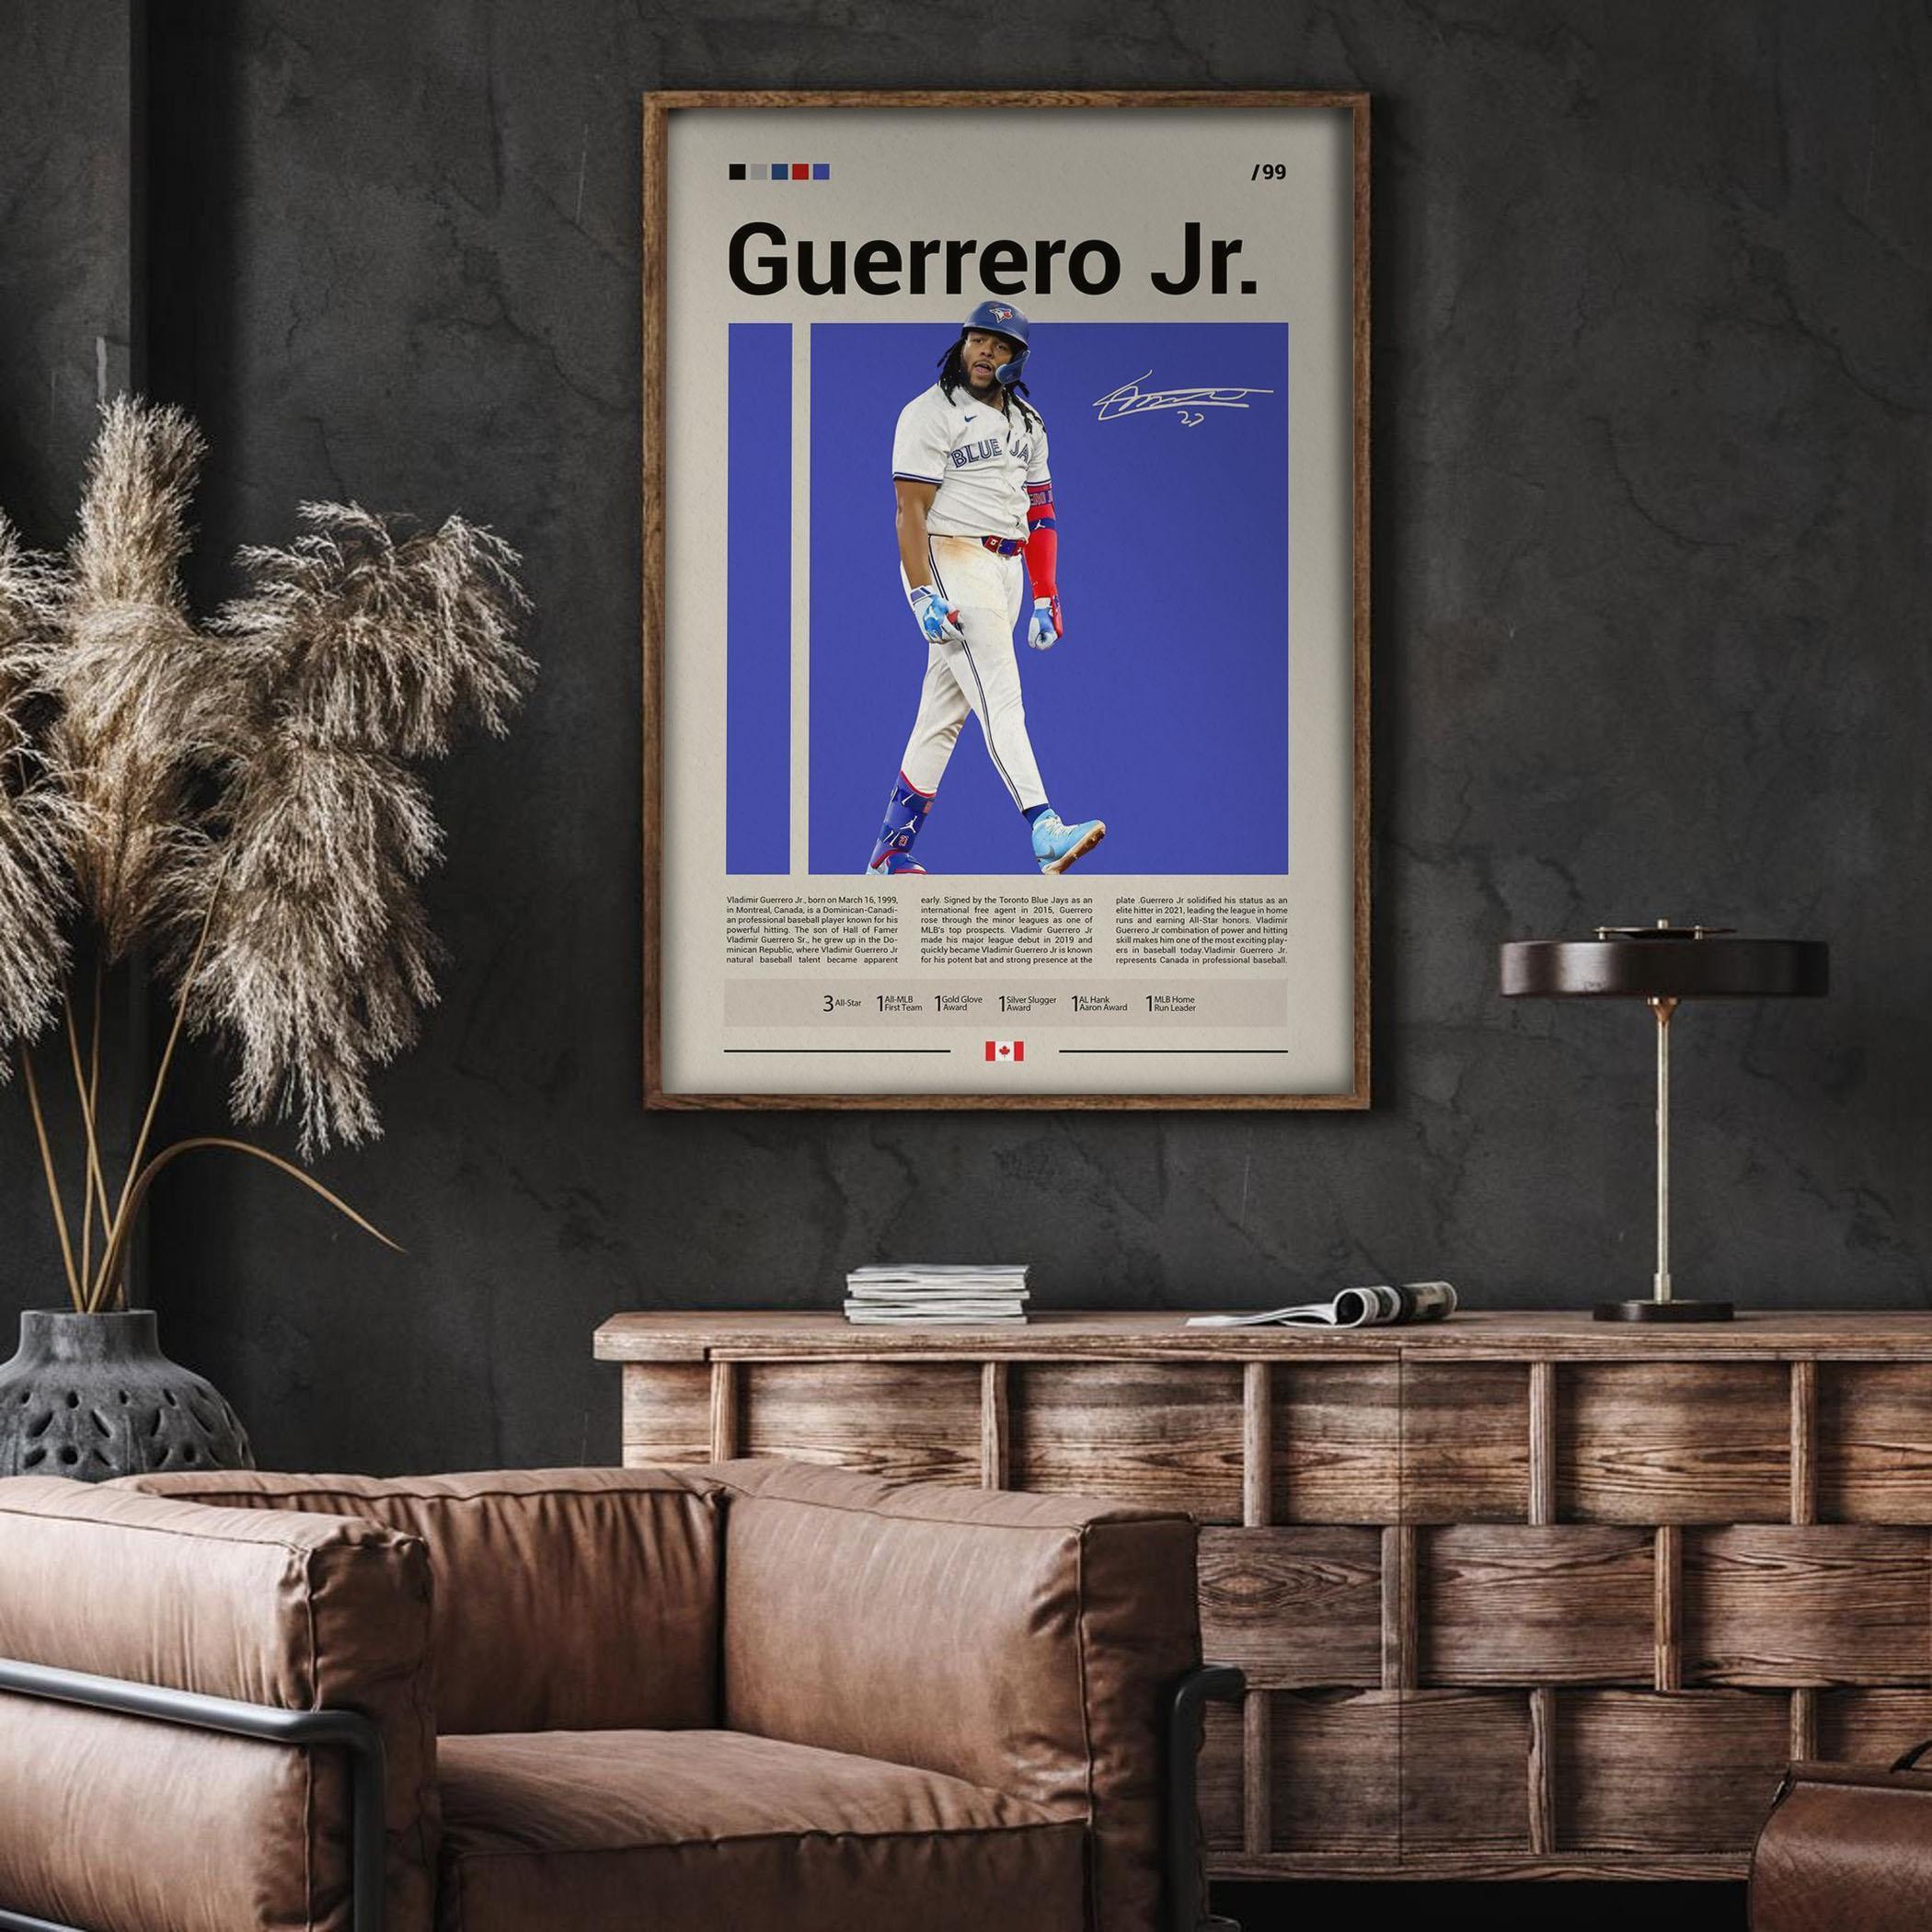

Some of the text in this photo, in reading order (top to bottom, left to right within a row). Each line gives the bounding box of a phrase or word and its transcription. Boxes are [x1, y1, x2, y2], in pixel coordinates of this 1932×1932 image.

[1251, 163, 1286, 180] /99
[729, 221, 1257, 295] Guerrero Jr.
[950, 438, 1003, 468] BLUE
[726, 896, 759, 904] Vladimir
[759, 896, 794, 904] Guerrero
[794, 896, 807, 905] Jr.,
[807, 896, 826, 904] born
[837, 896, 864, 904] March
[864, 896, 877, 905] 16,
[877, 896, 899, 905] 1999,
[920, 896, 942, 906] early.
[943, 896, 972, 906] Signed
[972, 896, 983, 906] by
[983, 896, 997, 904] the
[998, 896, 1029, 904] Toronto
[1030, 896, 1050, 904] Blue
[1050, 896, 1069, 906] Jays
[1115, 896, 1136, 906] plate
[1176, 896, 1184, 904] Jr
[1187, 896, 1223, 904] solidified
[1224, 896, 1236, 904] his
[1238, 896, 1264, 904] status
[726, 905, 734, 914] in
[735, 905, 773, 915] Montreal,
[773, 905, 805, 915] Canada,
[806, 905, 814, 914] is
[822, 905, 898, 914] Dominican-Canadi-
[920, 905, 1093, 916] international free agent in 2015, Guerrero
[738, 915, 786, 926] professional
[787, 915, 820, 924] baseball
[821, 915, 845, 926] player
[846, 915, 872, 924] known
[873, 915, 885, 924] for
[886, 915, 899, 924] his
[941, 915, 972, 926] through
[975, 915, 989, 924] the
[992, 915, 1016, 924] minor
[1018, 915, 1050, 926] leagues
[1084, 915, 1094, 924] of
[1136, 916, 1153, 925] and
[1156, 916, 1186, 926] earning
[1189, 916, 1219, 925] All-Star
[1222, 916, 1252, 925] honors.
[1255, 916, 1288, 925] Vladimir
[726, 926, 761, 936] powerful
[764, 926, 791, 936] hitting.
[794, 926, 810, 934] The
[831, 926, 840, 934] of
[843, 926, 858, 934] Hall
[861, 926, 870, 934] of
[873, 926, 899, 934] Famer
[920, 926, 1093, 936] MLB's top prospects. Vladimir Guerrero Jr
[1115, 926, 1288, 937] Guerrero Jr combination of power and hitting
[920, 936, 1093, 946] made his major league debut in 2019 and
[726, 946, 899, 956] minican Republic, where Vladimir Guerrero Jr
[920, 946, 1093, 956] quickly became Vladimir Guerrero Jr is known
[1132, 946, 1140, 954] in
[1143, 946, 1177, 954] baseball
[1239, 946, 1274, 954] Guerrero
[1277, 946, 1288, 954] Jr.
[726, 956, 899, 966] natural baseball talent became apparent
[1115, 956, 1288, 966] represents Canada in professional baseball.
[822, 995, 862, 1012] 3 All-Star
[877, 995, 914, 1012] 1 All-MLB
[884, 1004, 923, 1012] First Team
[935, 995, 983, 1012] 1 Gold Glove
[943, 1004, 968, 1012] Award
[998, 995, 1057, 1013] 1 Silver Slugger
[1006, 1004, 1031, 1012] Award
[1071, 995, 1110, 1012] 1 AL Hank
[1078, 1004, 1128, 1012] Aaron Award
[1145, 995, 1195, 1012] 1 MLB Home
[1154, 1004, 1197, 1012] Run Leader
